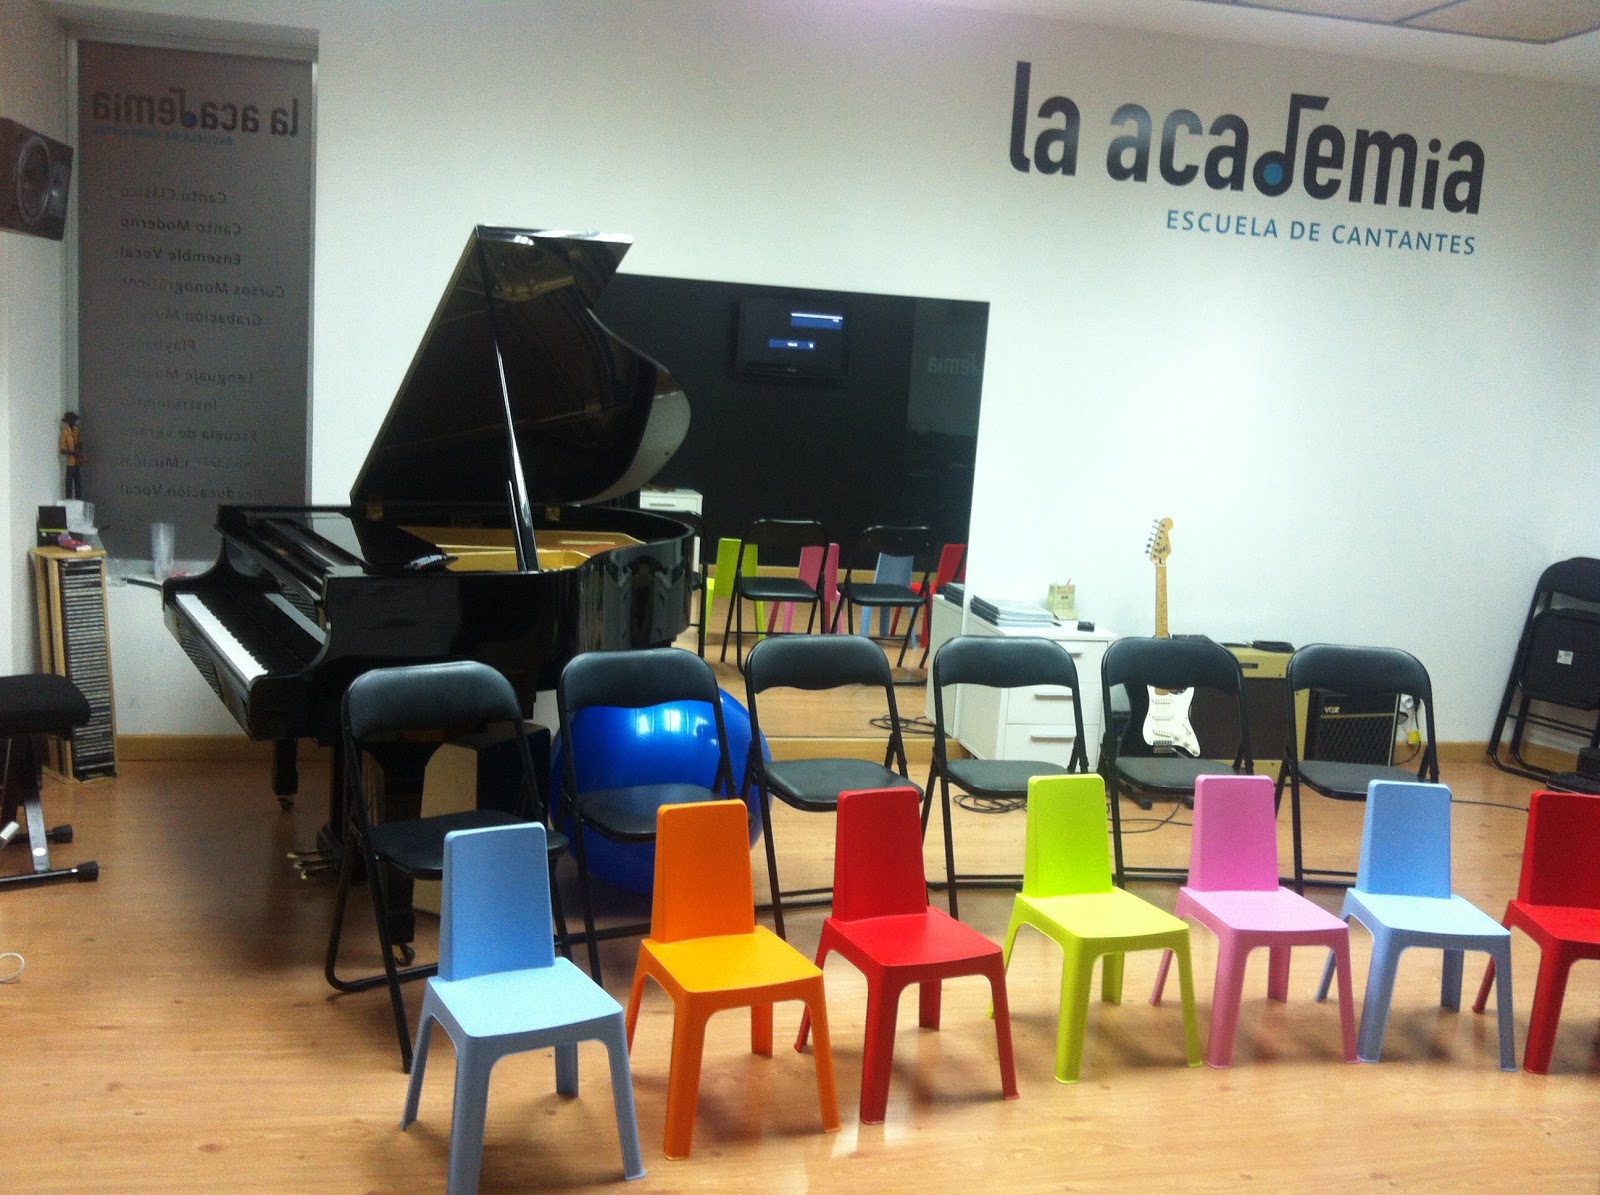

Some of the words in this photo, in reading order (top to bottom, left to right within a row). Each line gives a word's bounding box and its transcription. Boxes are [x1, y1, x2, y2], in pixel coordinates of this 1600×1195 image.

[1009, 61, 1080, 176] la
[1106, 93, 1486, 215] academia
[1166, 210, 1278, 238] ESCUELA
[1289, 220, 1321, 242] DE
[1332, 224, 1476, 256] CANTANTES
